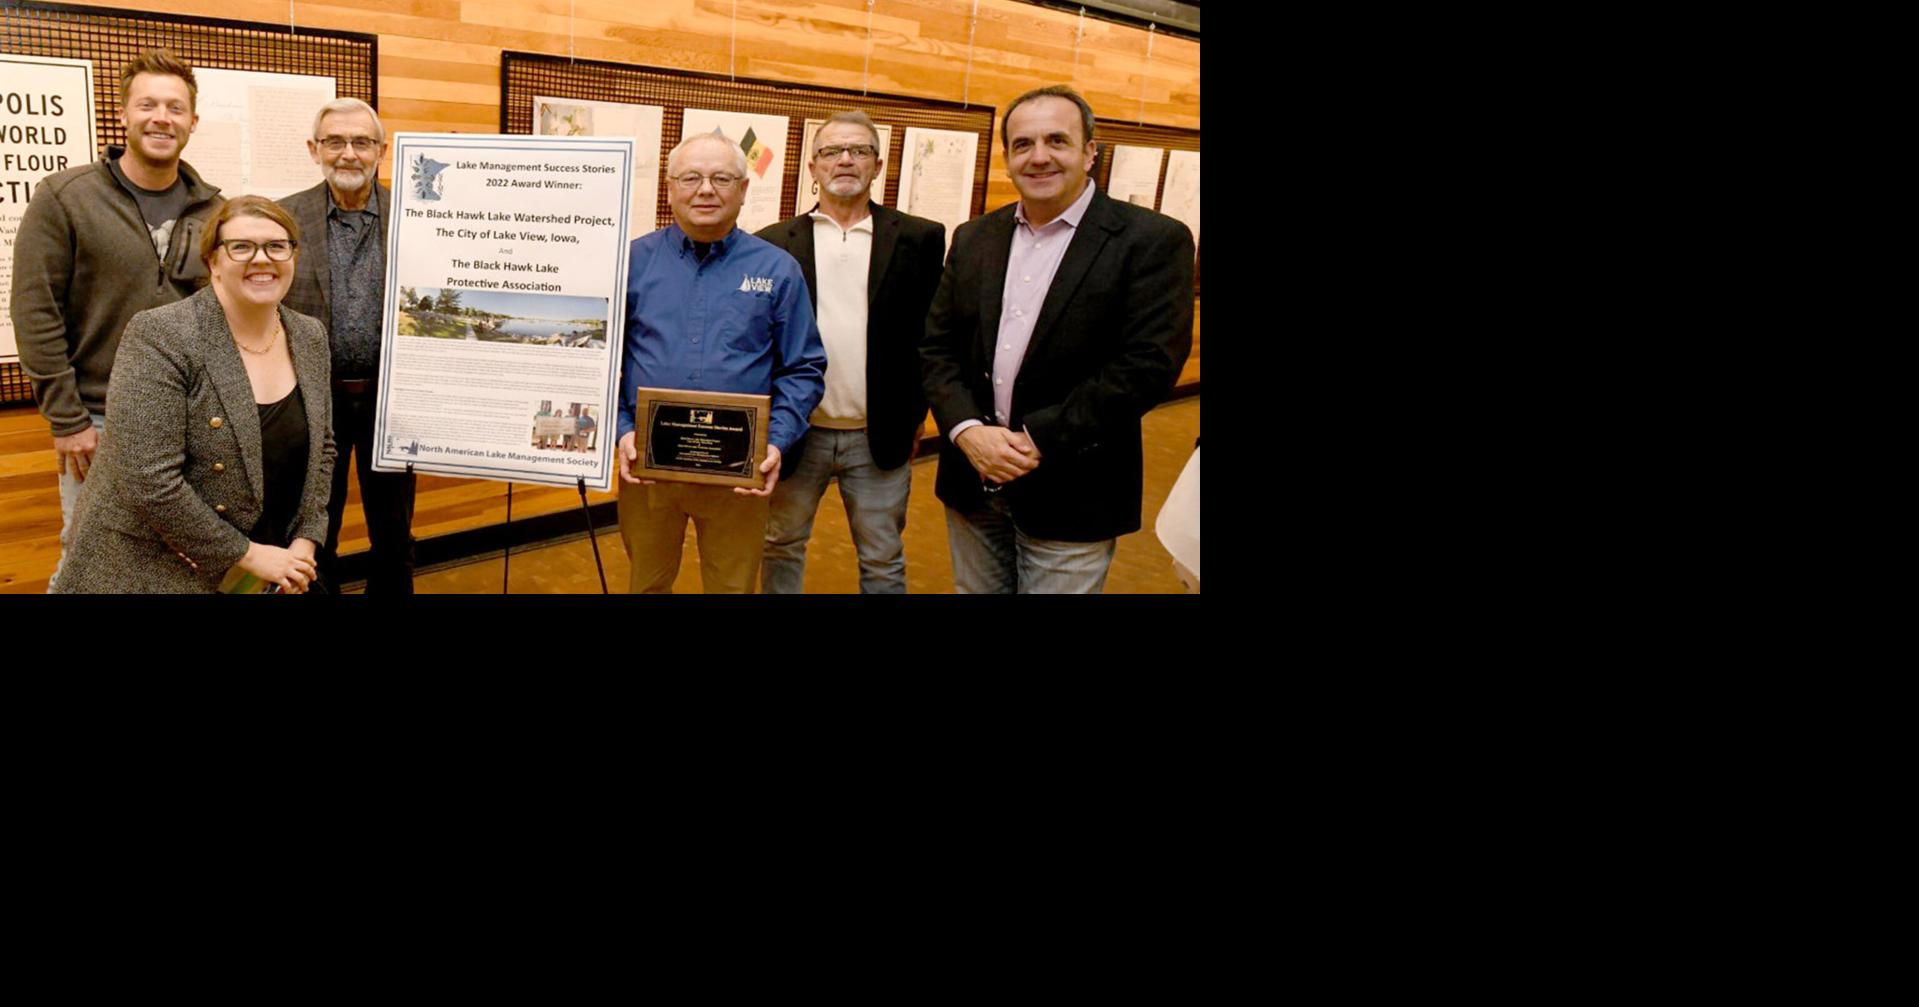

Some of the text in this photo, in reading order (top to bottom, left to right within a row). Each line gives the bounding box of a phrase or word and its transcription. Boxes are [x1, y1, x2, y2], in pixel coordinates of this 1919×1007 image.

[4, 154, 68, 172] FLOUR
[456, 160, 616, 174] Lake Management Success Stories
[485, 178, 583, 190] 2022 Award Winner:
[405, 208, 615, 227] The Black Hawk Lake Watershed Project,
[436, 228, 580, 244] The City of Lake View, Iowa,
[451, 259, 559, 273] The Black Hawk Lake
[446, 277, 562, 292] Protective Association
[750, 276, 774, 285] LAKE
[419, 444, 599, 468] North American Lake Management Society
